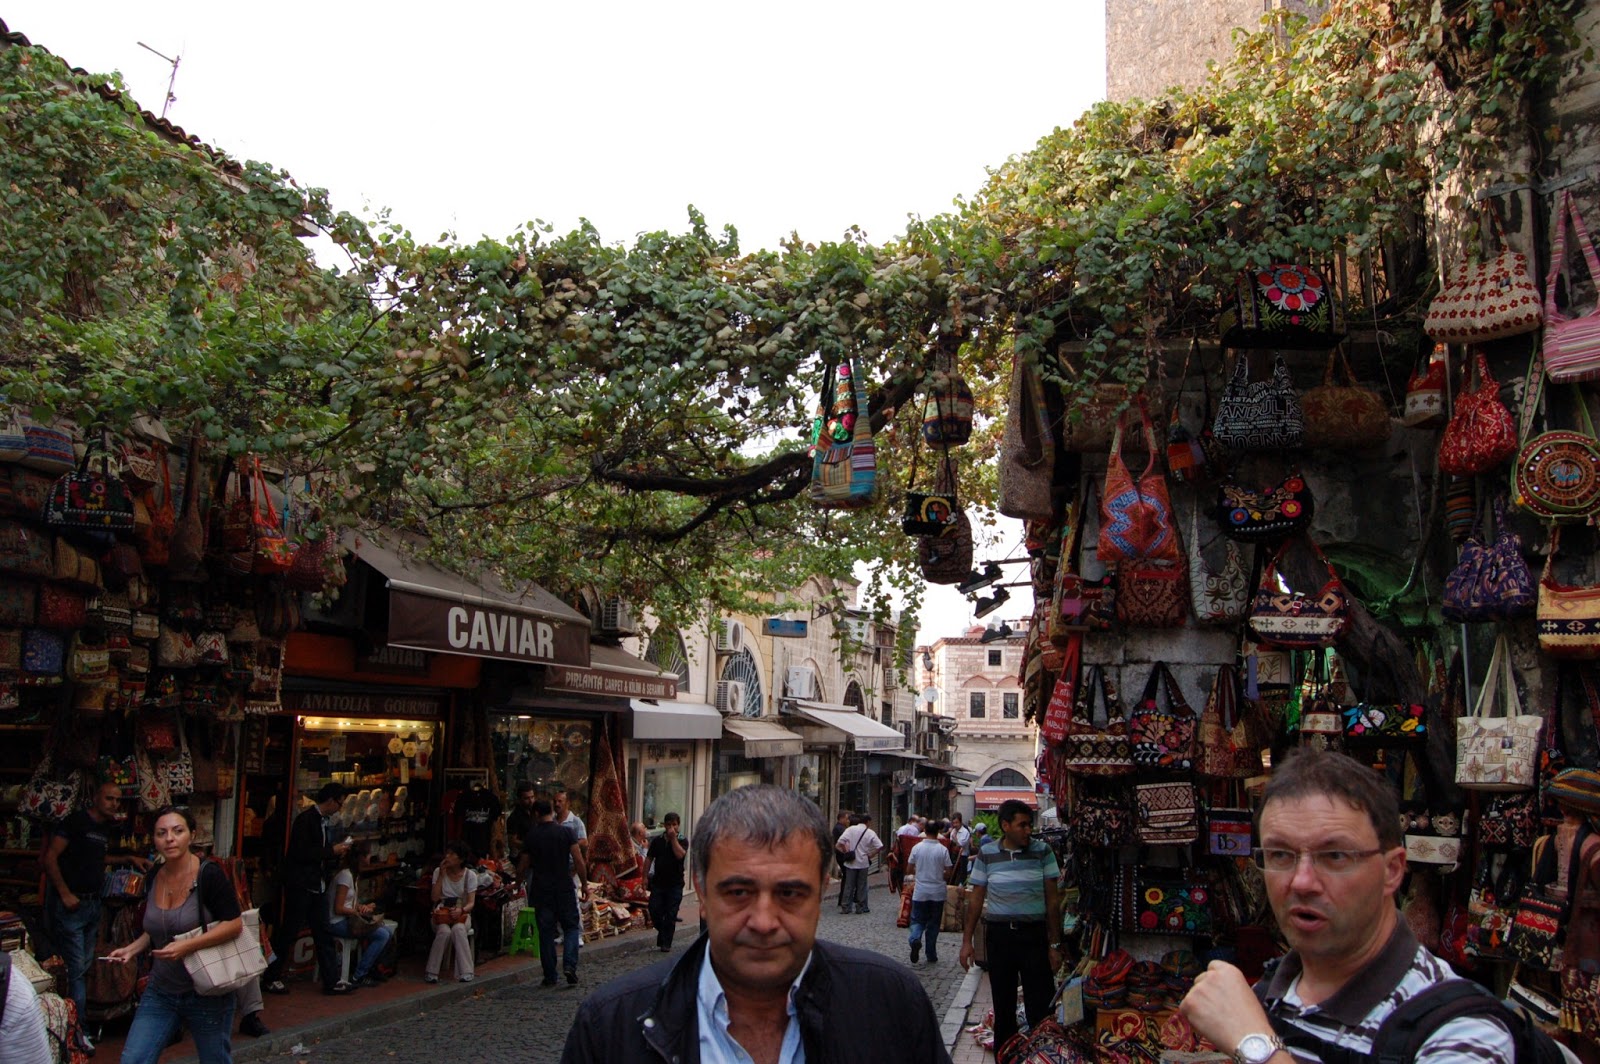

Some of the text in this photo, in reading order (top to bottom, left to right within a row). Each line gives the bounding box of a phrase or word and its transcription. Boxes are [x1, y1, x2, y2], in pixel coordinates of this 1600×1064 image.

[447, 606, 554, 659] CAVIAR
[604, 678, 623, 693] CARPET
[301, 694, 440, 715] ANATOLIA GOURMET
